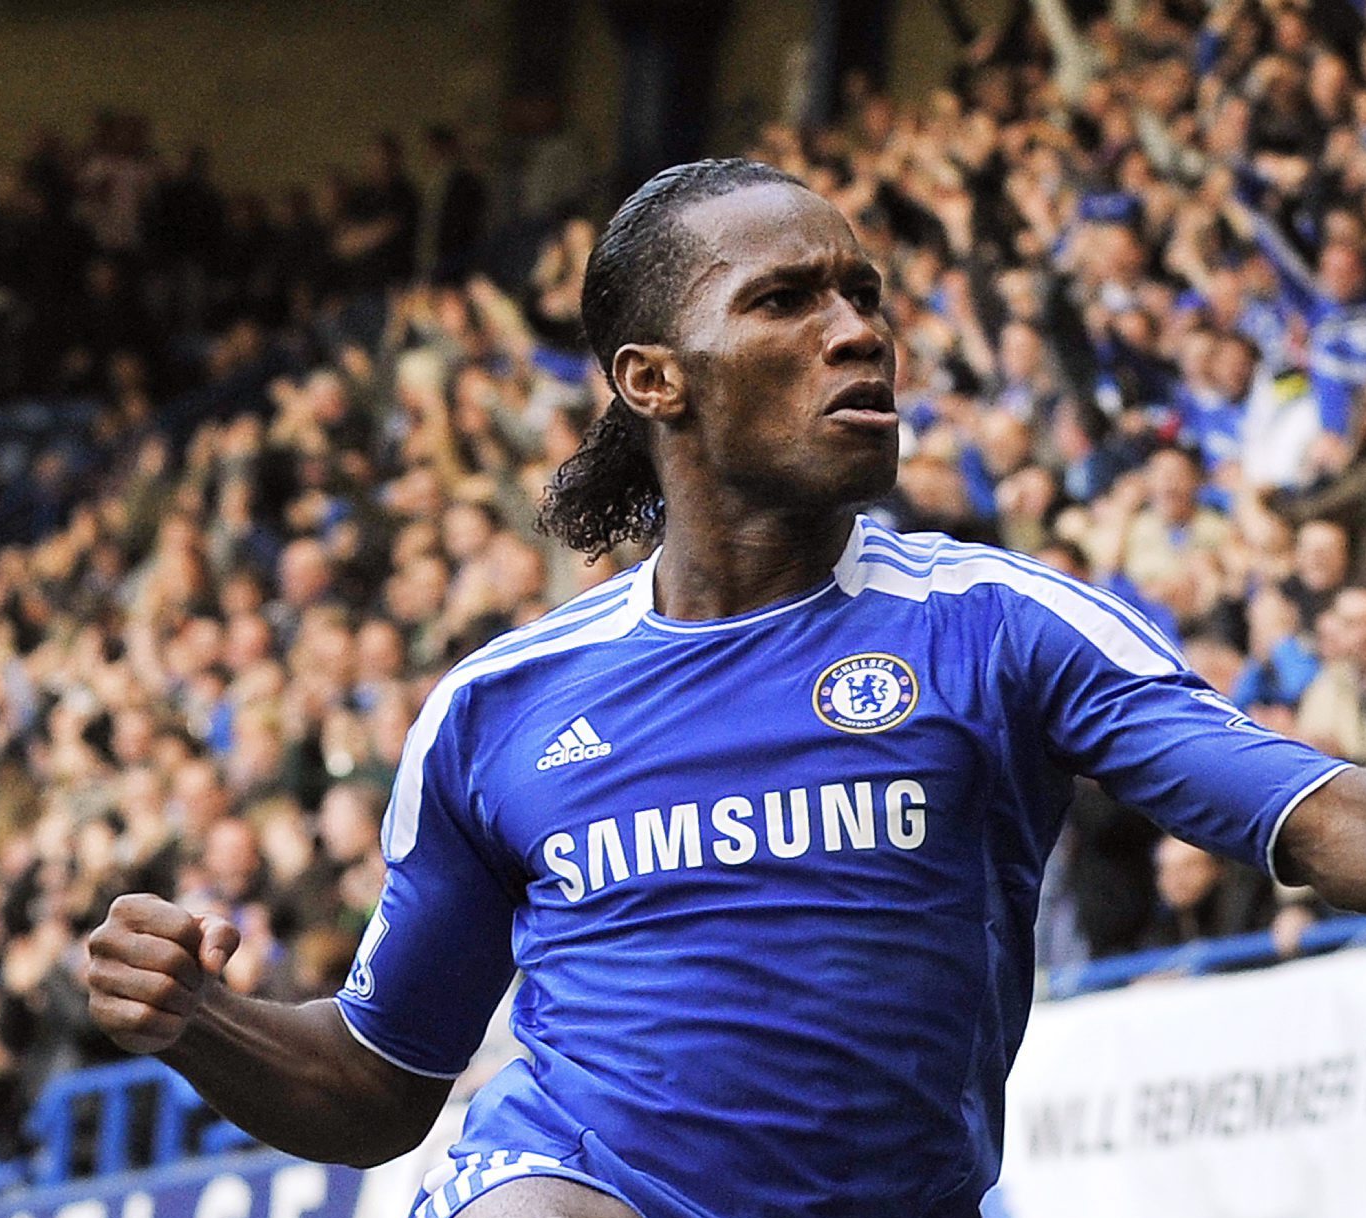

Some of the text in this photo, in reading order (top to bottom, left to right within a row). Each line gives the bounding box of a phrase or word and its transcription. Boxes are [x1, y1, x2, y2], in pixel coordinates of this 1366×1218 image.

[830, 659, 895, 680] CHELSEA
[536, 742, 612, 771] adidas
[542, 779, 928, 903] SAMSUNG
